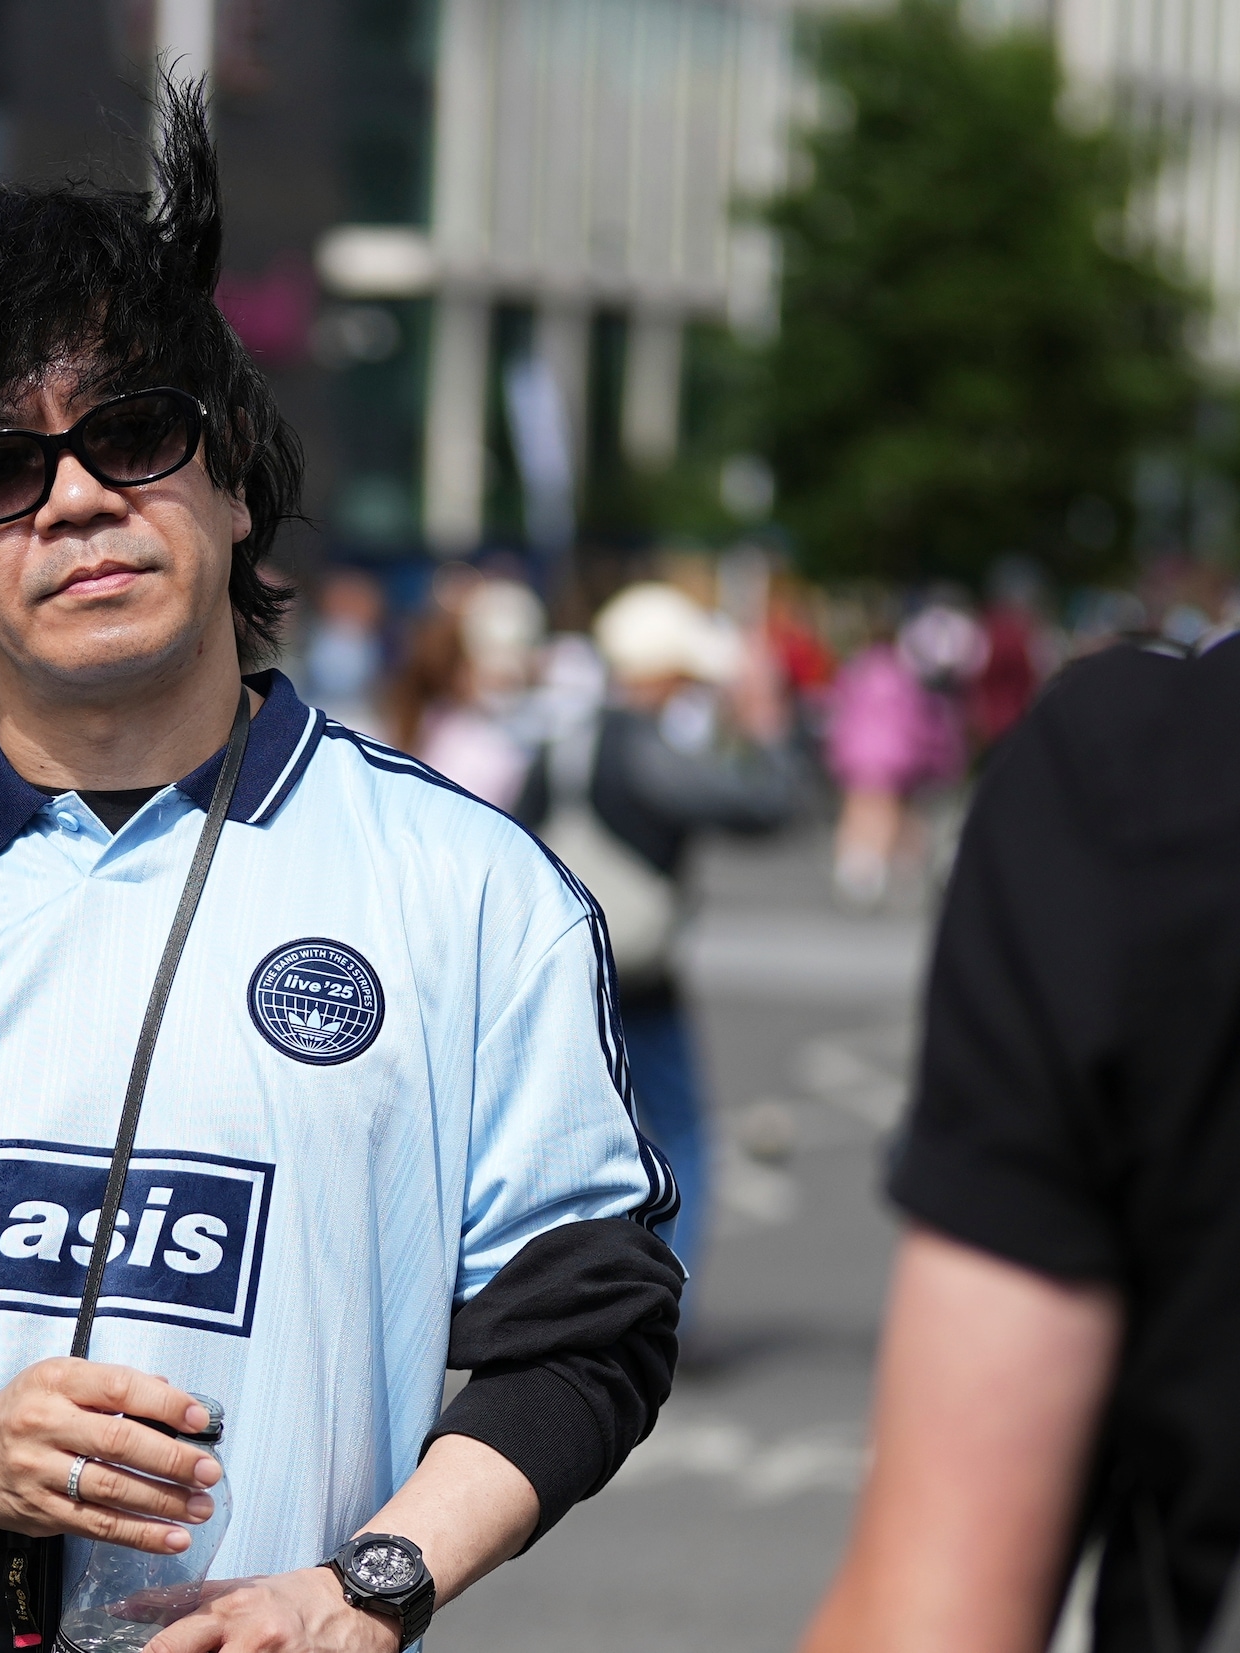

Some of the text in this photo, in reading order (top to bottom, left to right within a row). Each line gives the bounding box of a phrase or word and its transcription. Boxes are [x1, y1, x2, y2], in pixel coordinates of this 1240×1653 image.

[263, 949, 373, 1008] THE BAND WITH THE 3 STRIPES
[283, 973, 322, 993] live
